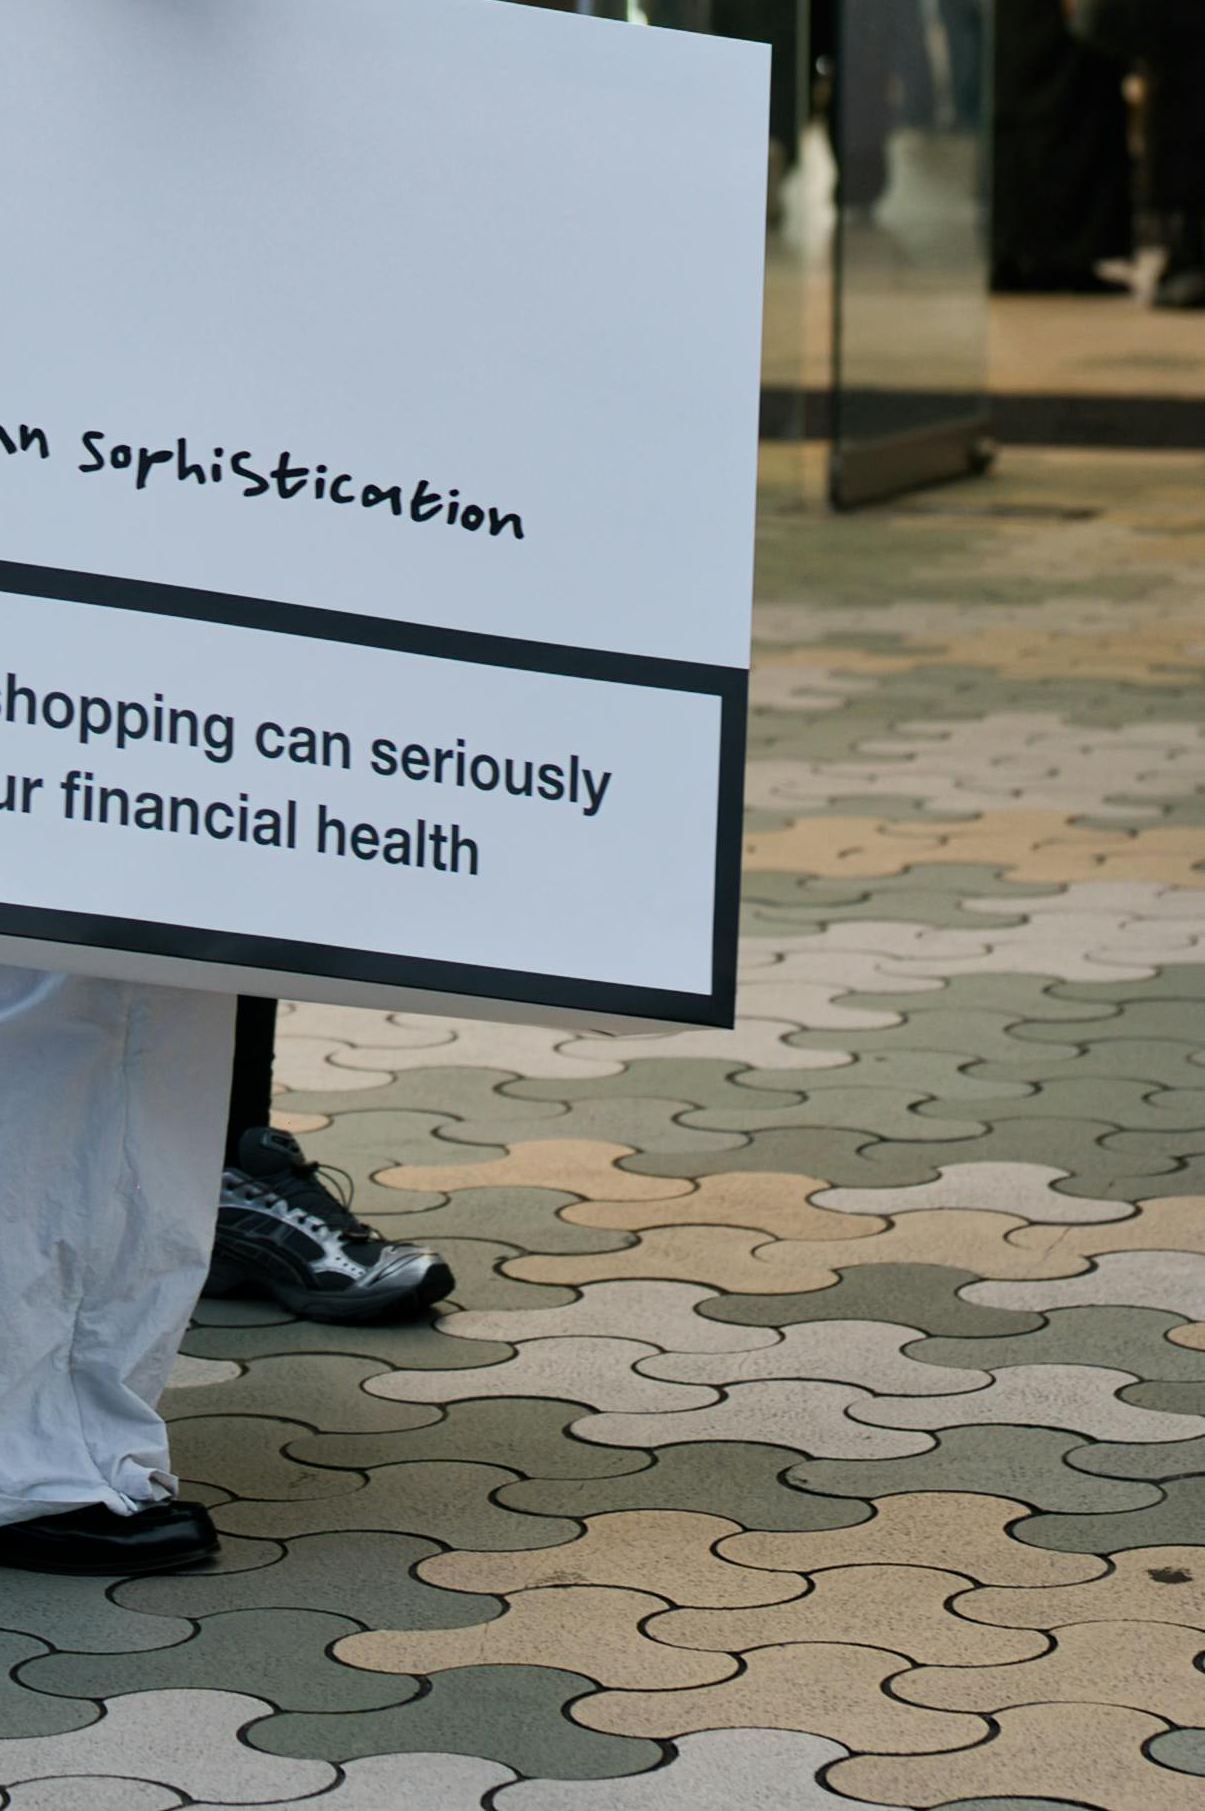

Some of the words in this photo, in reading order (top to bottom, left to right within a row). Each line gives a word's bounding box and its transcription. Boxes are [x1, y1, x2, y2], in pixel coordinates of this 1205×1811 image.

[255, 720, 352, 770] can
[370, 738, 612, 818] seriously
[60, 769, 297, 849] financial
[317, 804, 479, 876] health
